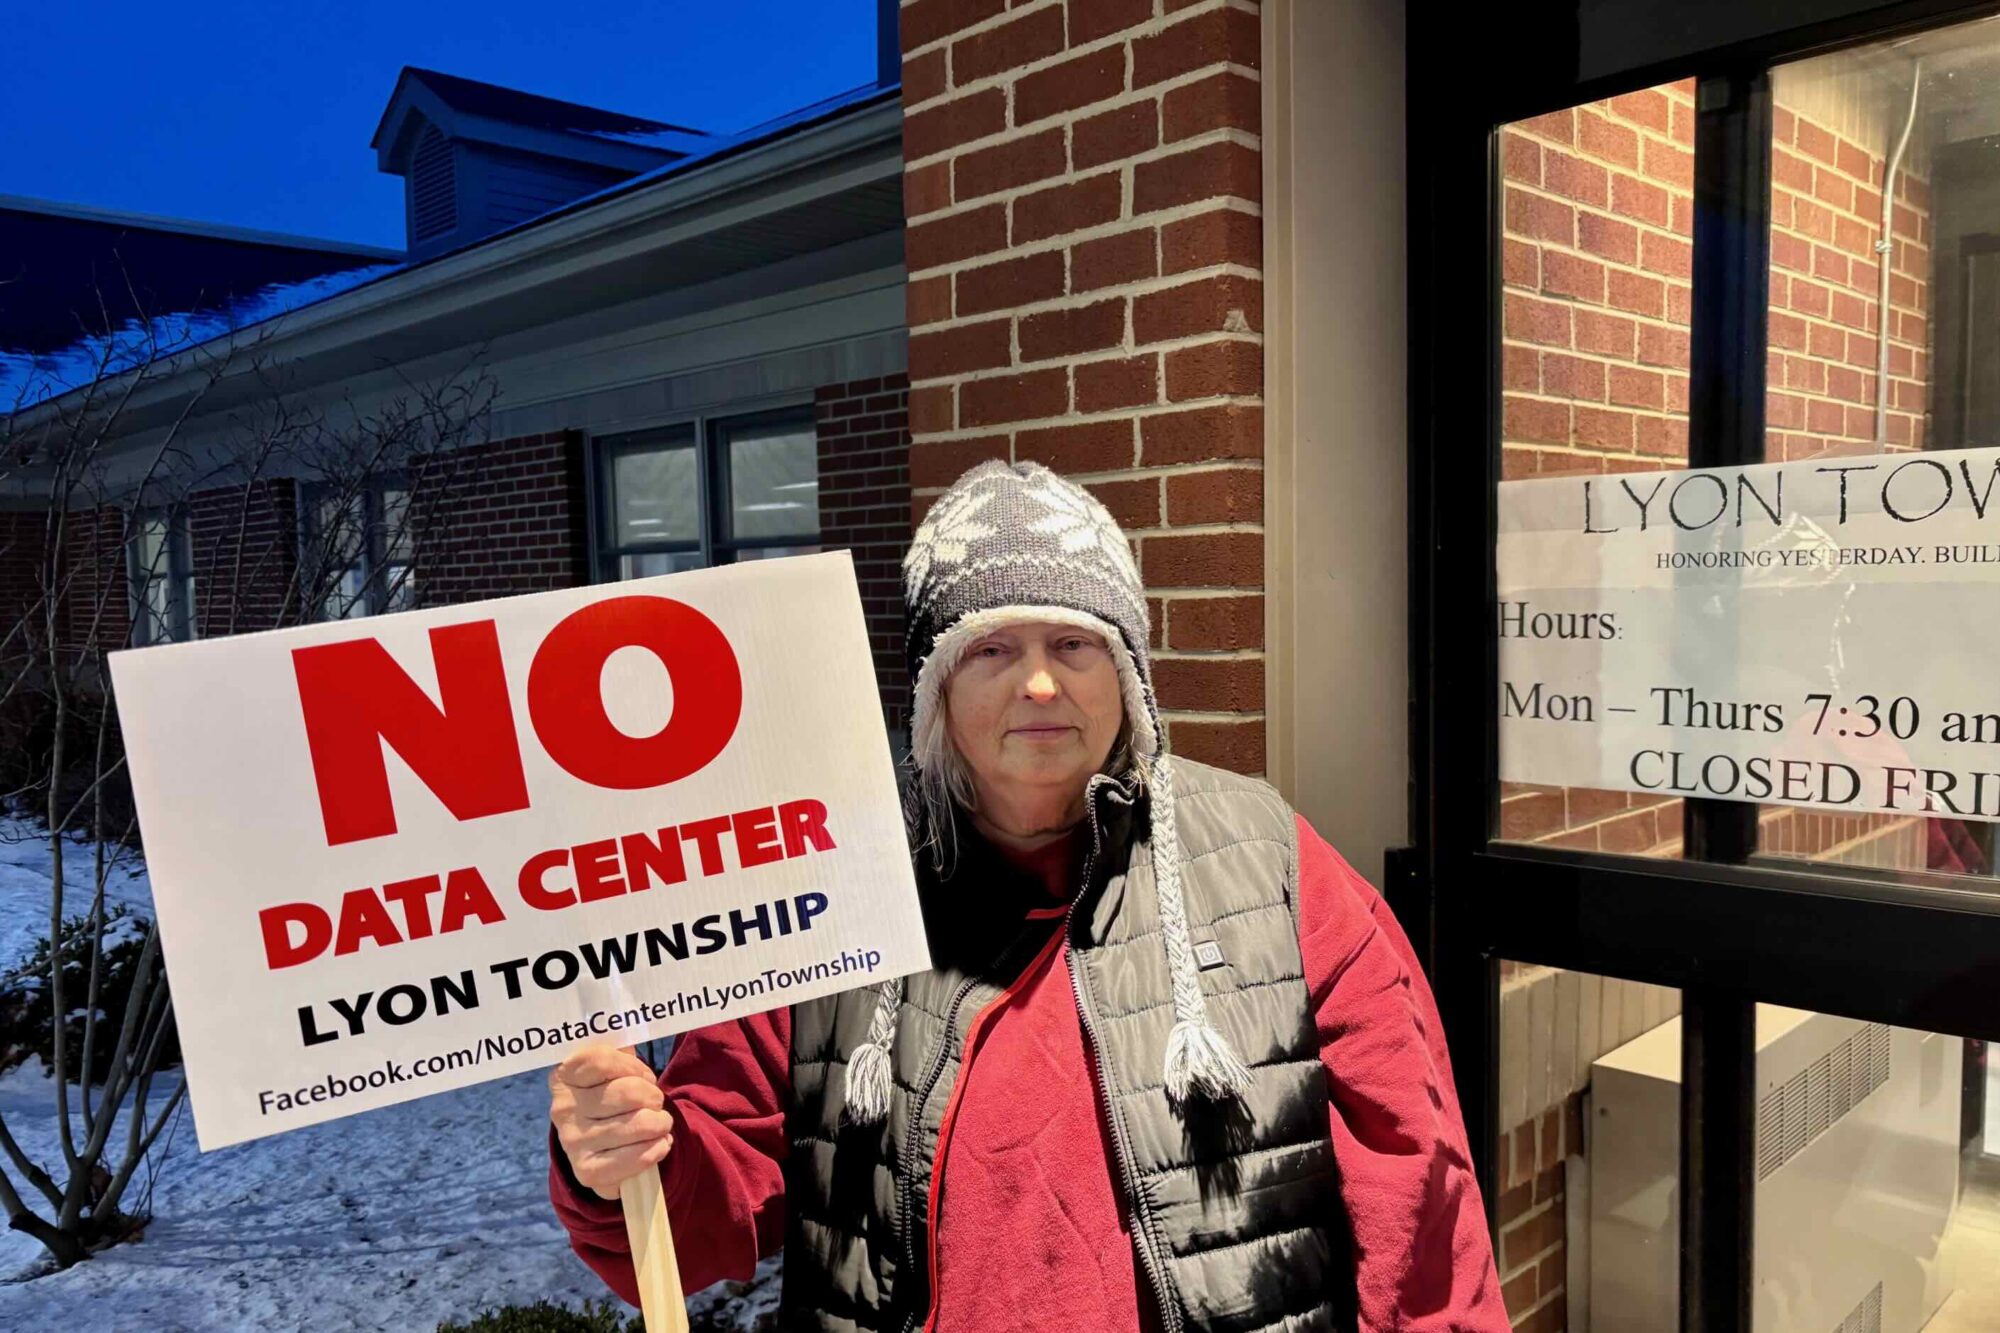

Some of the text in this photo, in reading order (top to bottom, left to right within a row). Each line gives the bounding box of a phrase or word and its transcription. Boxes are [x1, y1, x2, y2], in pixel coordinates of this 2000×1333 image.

[1583, 472, 1782, 534] LYON
[1656, 551, 1772, 569] HONORING
[1935, 544, 2000, 563] BUIL
[1499, 601, 1623, 640] Hours:
[292, 594, 743, 846] NO
[1502, 681, 1595, 722] Mon
[1650, 686, 1784, 733] Thurs
[1804, 693, 1920, 740] 7:30
[1629, 749, 2000, 817] CLOSED FRI
[258, 798, 837, 971] DATA CENTER
[297, 891, 829, 1047] LYON TOWNSHIP
[258, 946, 882, 1115] Facebook.com/NoDataCenterInLyonTownship
